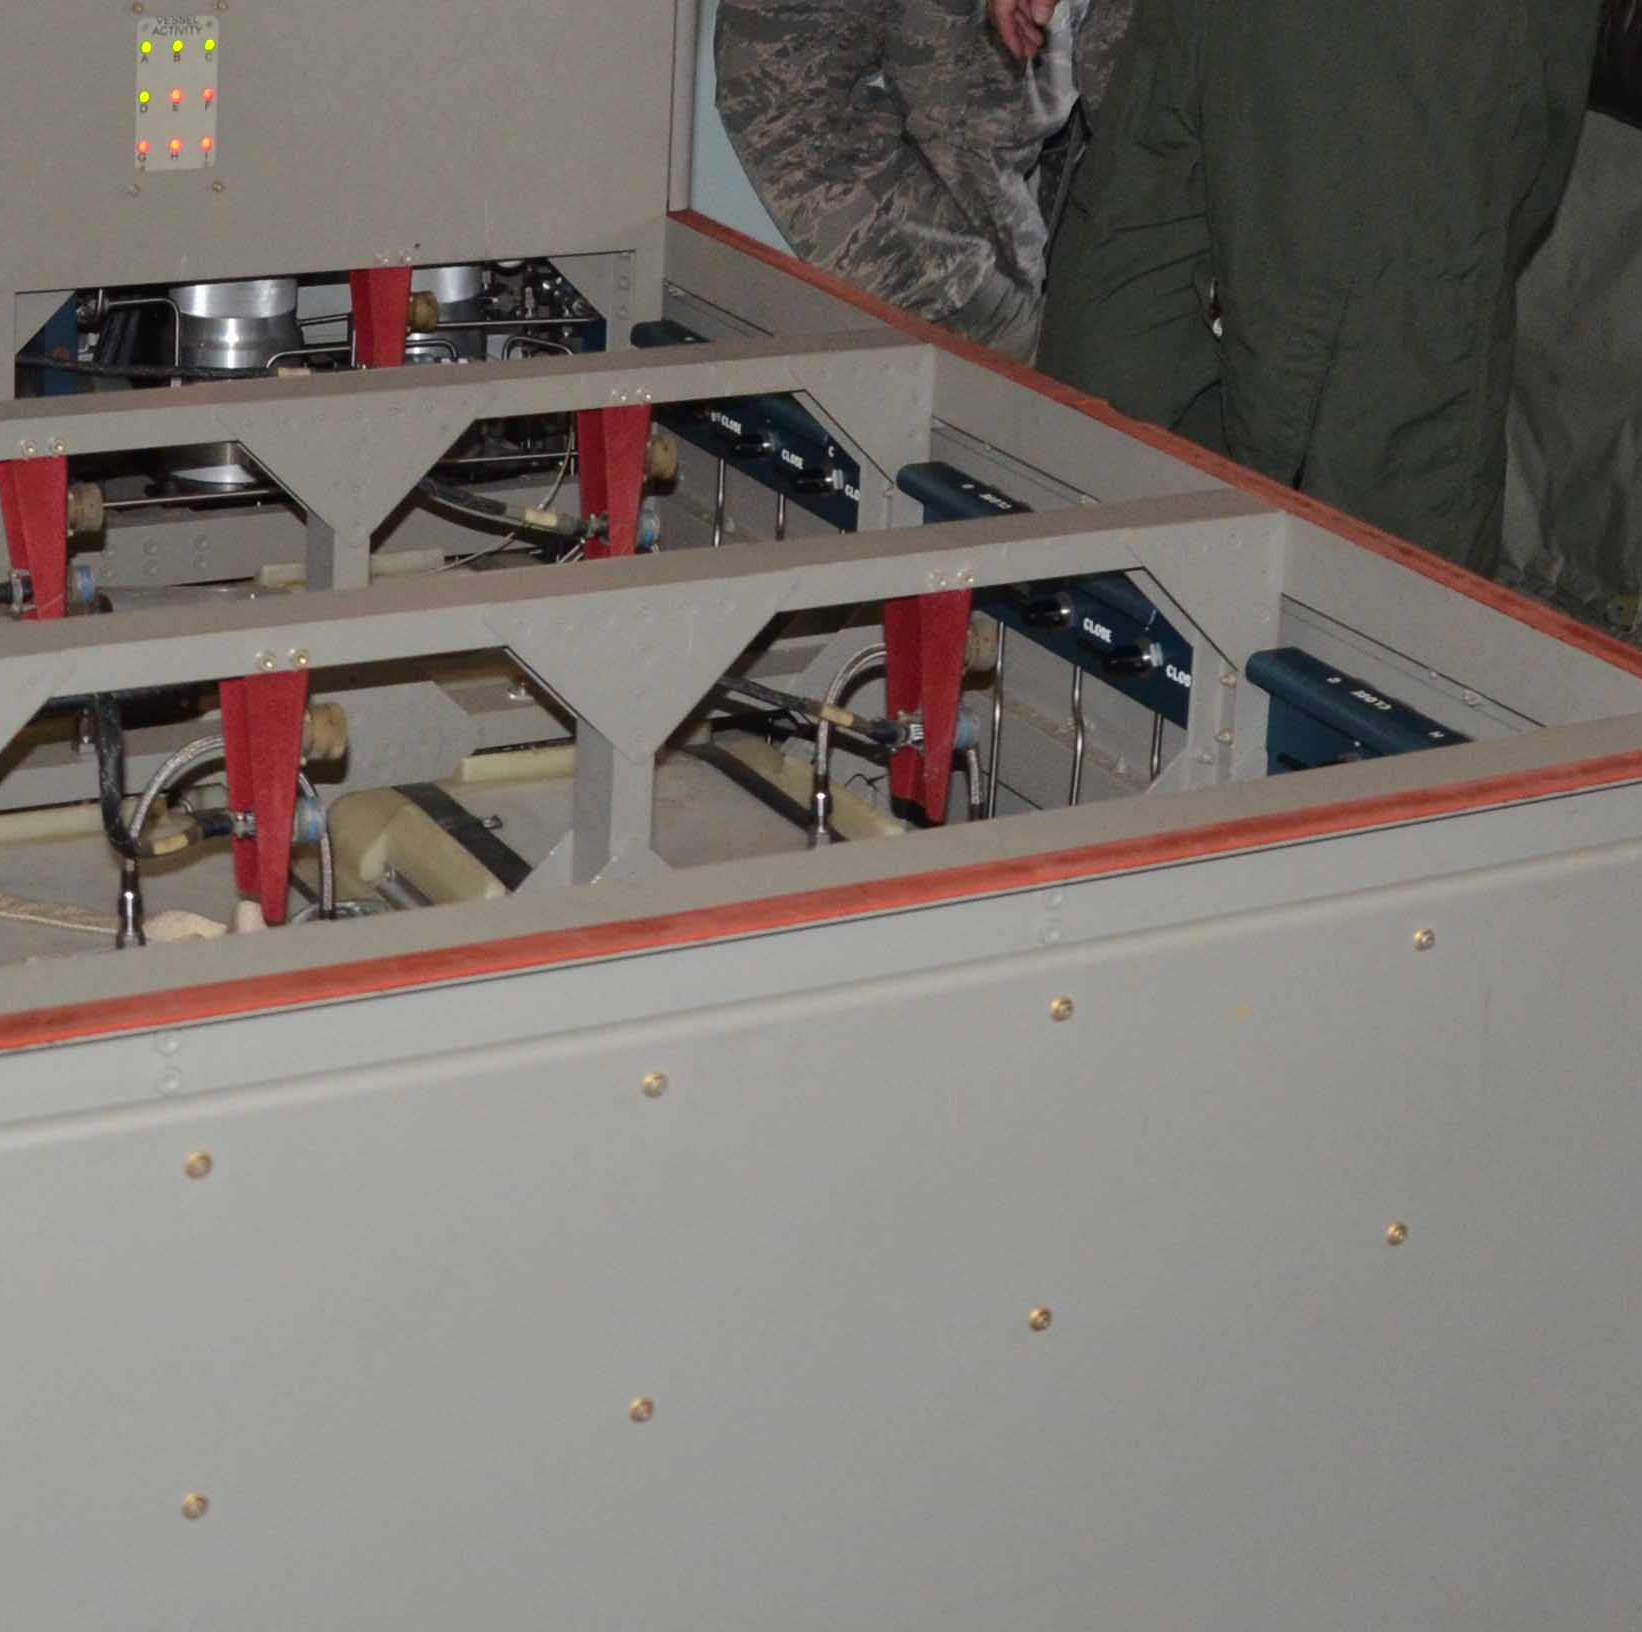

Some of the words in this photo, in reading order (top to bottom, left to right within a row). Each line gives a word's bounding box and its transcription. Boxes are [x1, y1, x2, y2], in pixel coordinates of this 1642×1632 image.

[156, 15, 198, 25] VESSEL
[152, 25, 202, 36] ACTIVITY
[844, 483, 860, 501] CLO
[1083, 617, 1112, 643] CLOSE
[1165, 664, 1192, 687] CLOS
